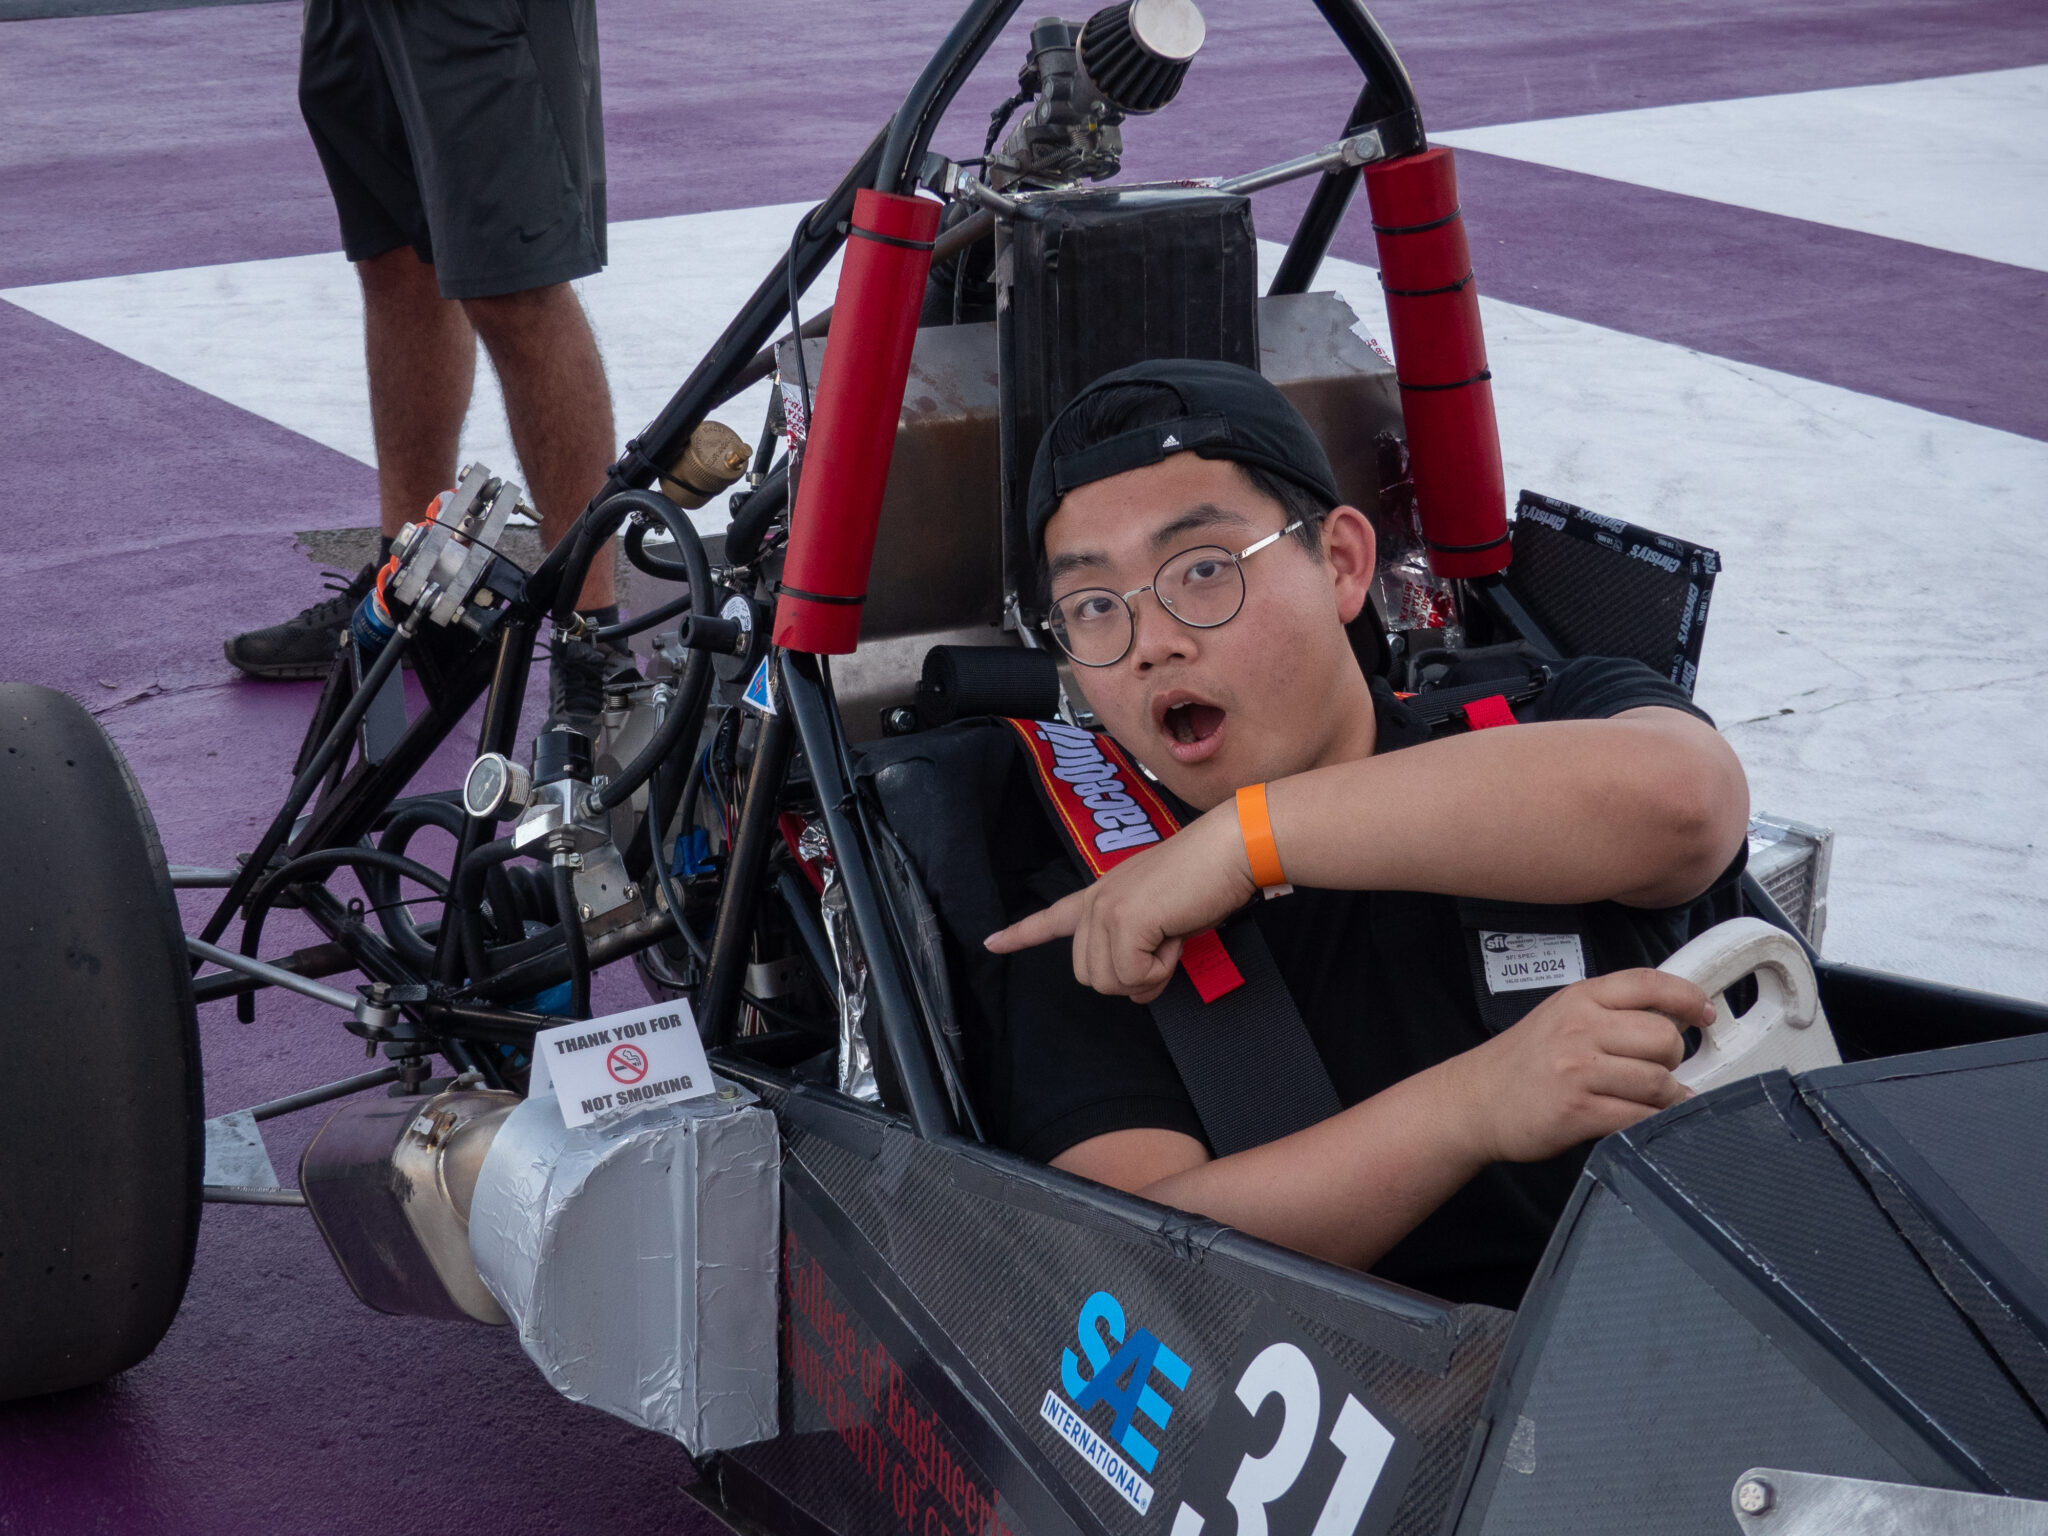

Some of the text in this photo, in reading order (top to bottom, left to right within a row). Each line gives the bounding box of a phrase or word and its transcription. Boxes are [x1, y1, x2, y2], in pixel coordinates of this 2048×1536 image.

[1521, 504, 1567, 531] Christy's
[1629, 544, 1680, 573] Christy's
[1501, 958, 1566, 976] JUN 2024
[554, 1013, 682, 1055] THANK YOU FOR
[581, 1075, 693, 1115] NOT SMOKING
[784, 1231, 856, 1379] College
[862, 1343, 886, 1413] of
[1061, 1291, 1192, 1474] SAE
[785, 1315, 888, 1492] UNIVERSITY
[893, 1463, 919, 1533] OF
[1170, 1342, 1396, 1536] 31
